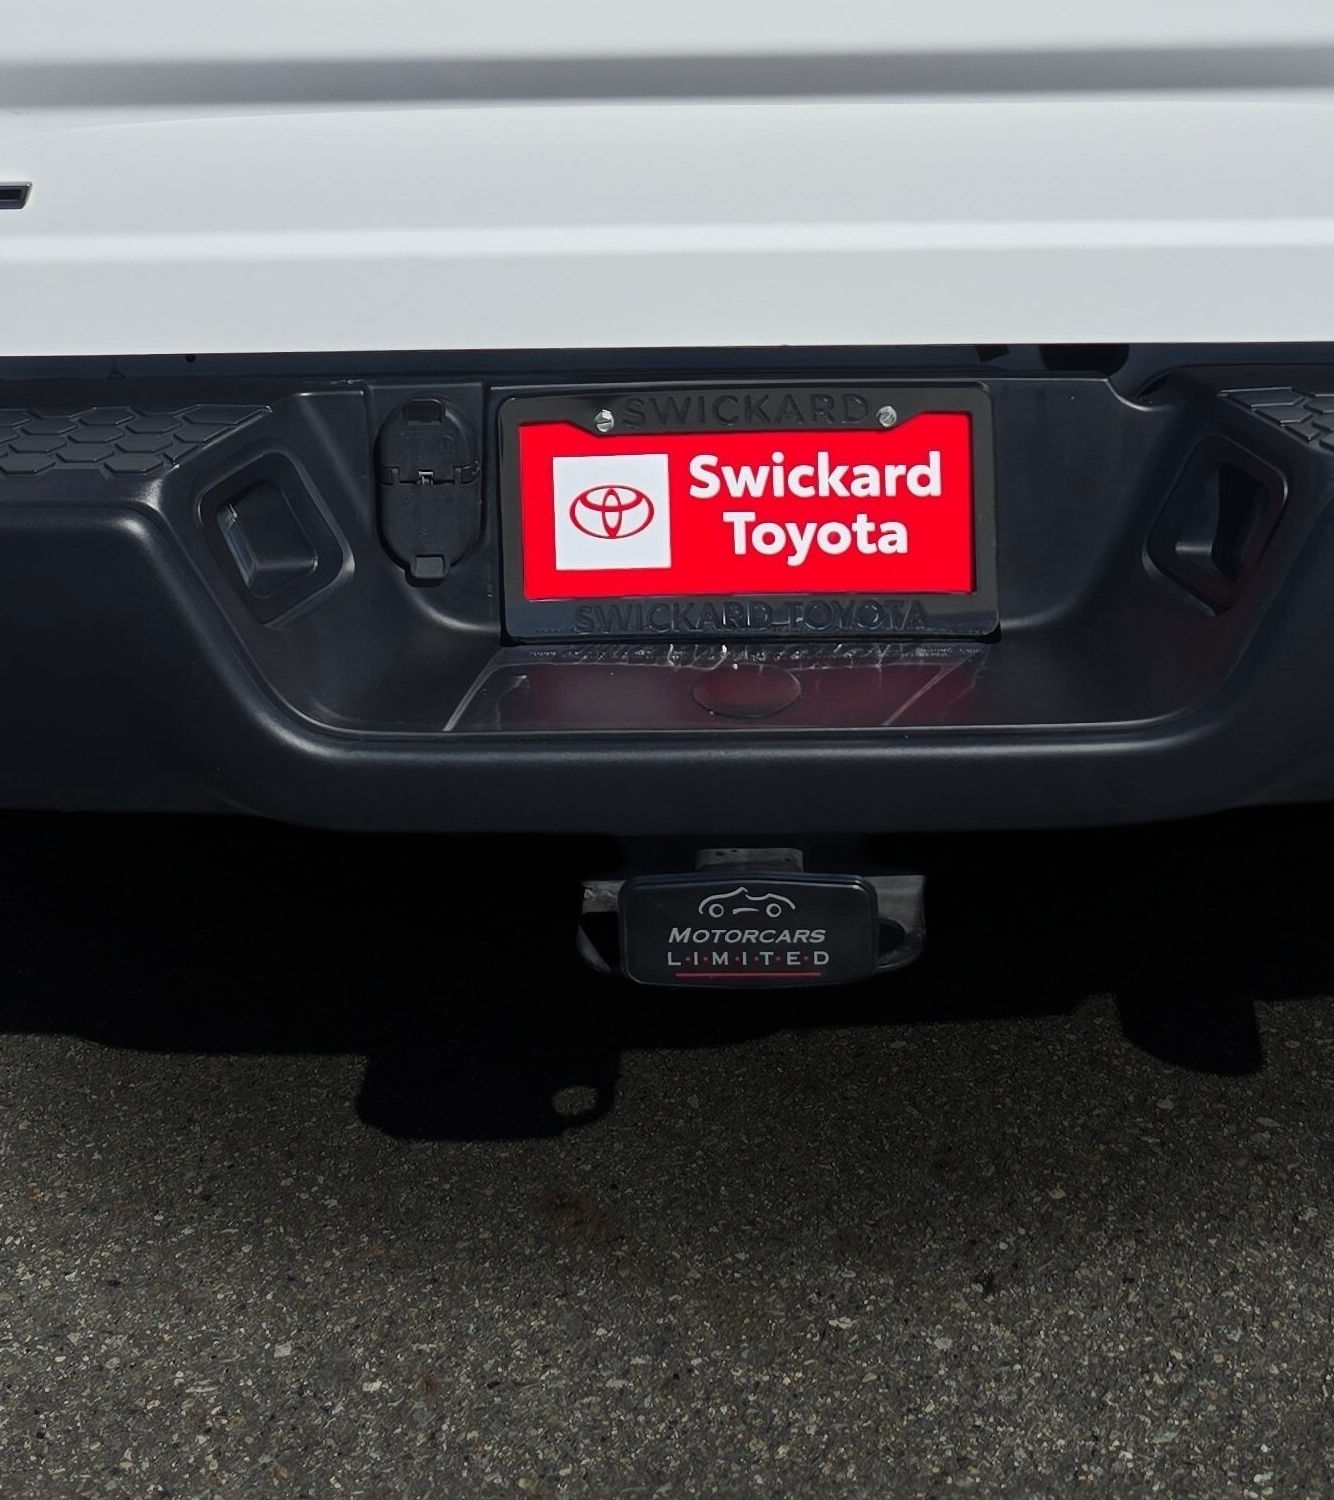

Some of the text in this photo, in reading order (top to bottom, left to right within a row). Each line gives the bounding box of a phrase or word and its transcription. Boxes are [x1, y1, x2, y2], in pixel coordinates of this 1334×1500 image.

[621, 393, 869, 429] SWICKARD
[688, 450, 942, 498] Swickard
[722, 511, 908, 566] Toyota
[574, 599, 928, 633] SWICKARD TOYOTA
